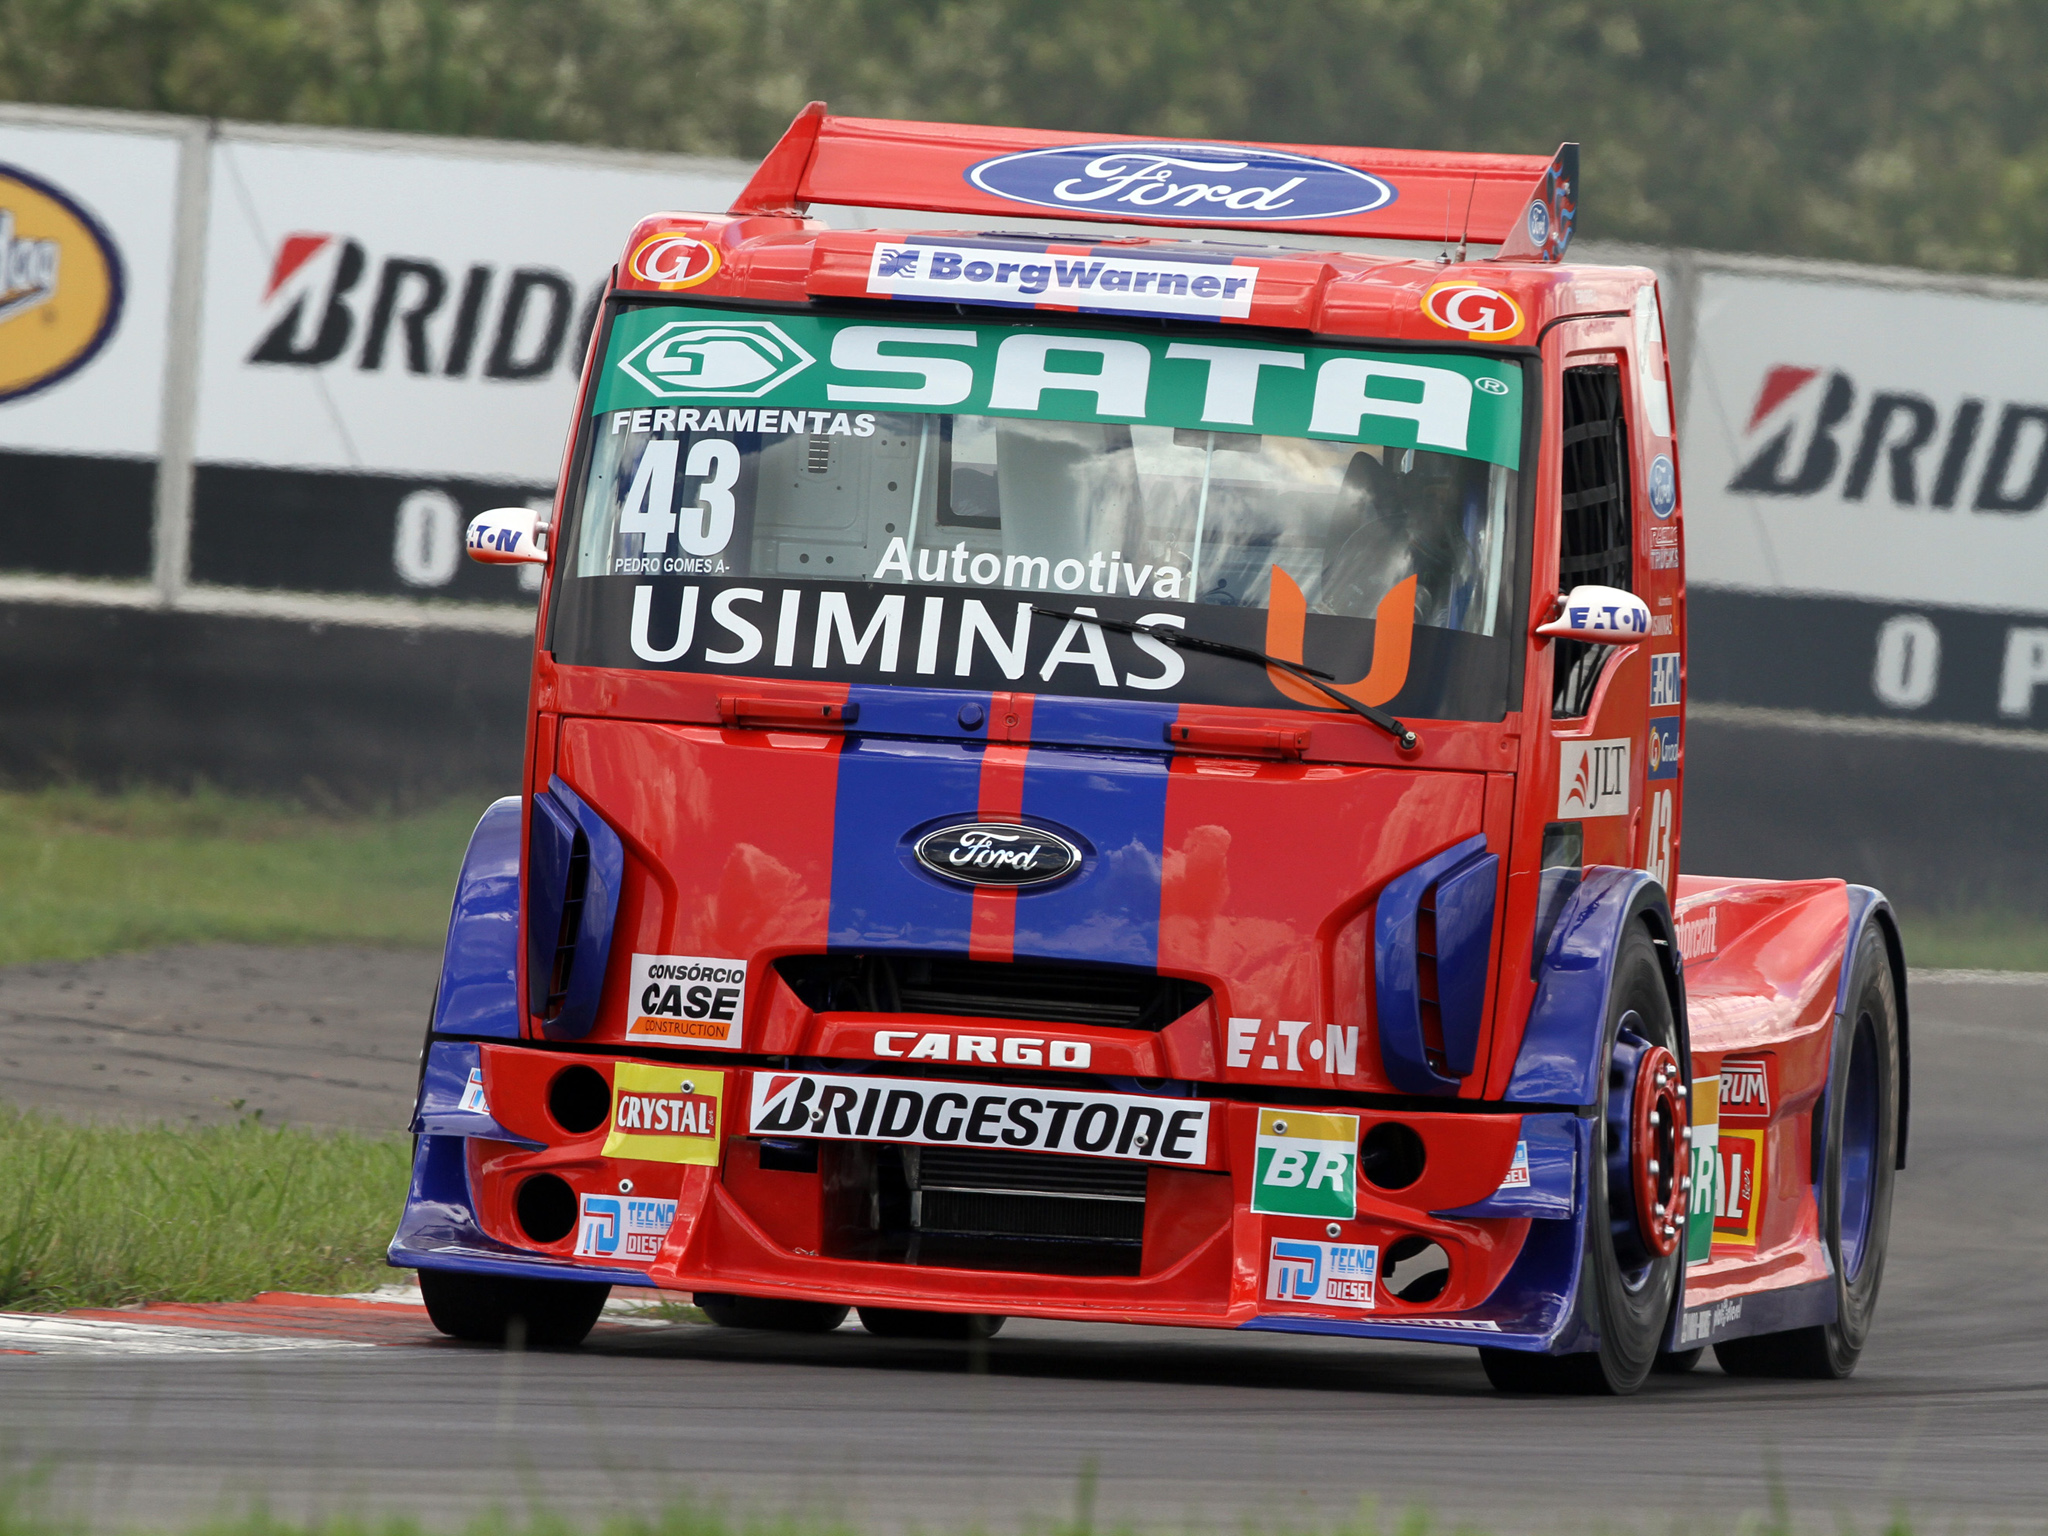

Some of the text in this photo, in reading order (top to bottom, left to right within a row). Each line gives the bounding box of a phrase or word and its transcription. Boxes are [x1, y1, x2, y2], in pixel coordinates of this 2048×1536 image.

[1053, 153, 1307, 211] Ford
[929, 252, 1248, 300] BorgWarner
[244, 232, 603, 381] BRID
[826, 325, 1474, 452] SATA
[612, 409, 877, 438] FERRAMENTAS
[619, 438, 741, 556] 43
[614, 557, 661, 573] PEDRO
[664, 557, 712, 573] GOMES
[873, 536, 1184, 599] Automotiva
[630, 585, 1187, 690] USIMINAS
[1568, 606, 1648, 634] EATON
[1589, 745, 1626, 810] JLT
[948, 830, 1042, 871] Ford
[648, 963, 745, 984] CONSÓRCIO
[641, 983, 741, 1021] CASE
[645, 1020, 725, 1037] CONSTRUCTION
[1226, 1017, 1359, 1076] EATON
[873, 1030, 1091, 1069] CARGO
[618, 1095, 711, 1135] CRYSTAL
[755, 1076, 1204, 1160] BRIDGESTONE
[1262, 1148, 1348, 1192] BR
[1742, 1167, 1751, 1201] Beer
[628, 1202, 677, 1228] TECNO
[1330, 1247, 1375, 1275] TECNO
[1327, 1279, 1372, 1301] DIESEL
